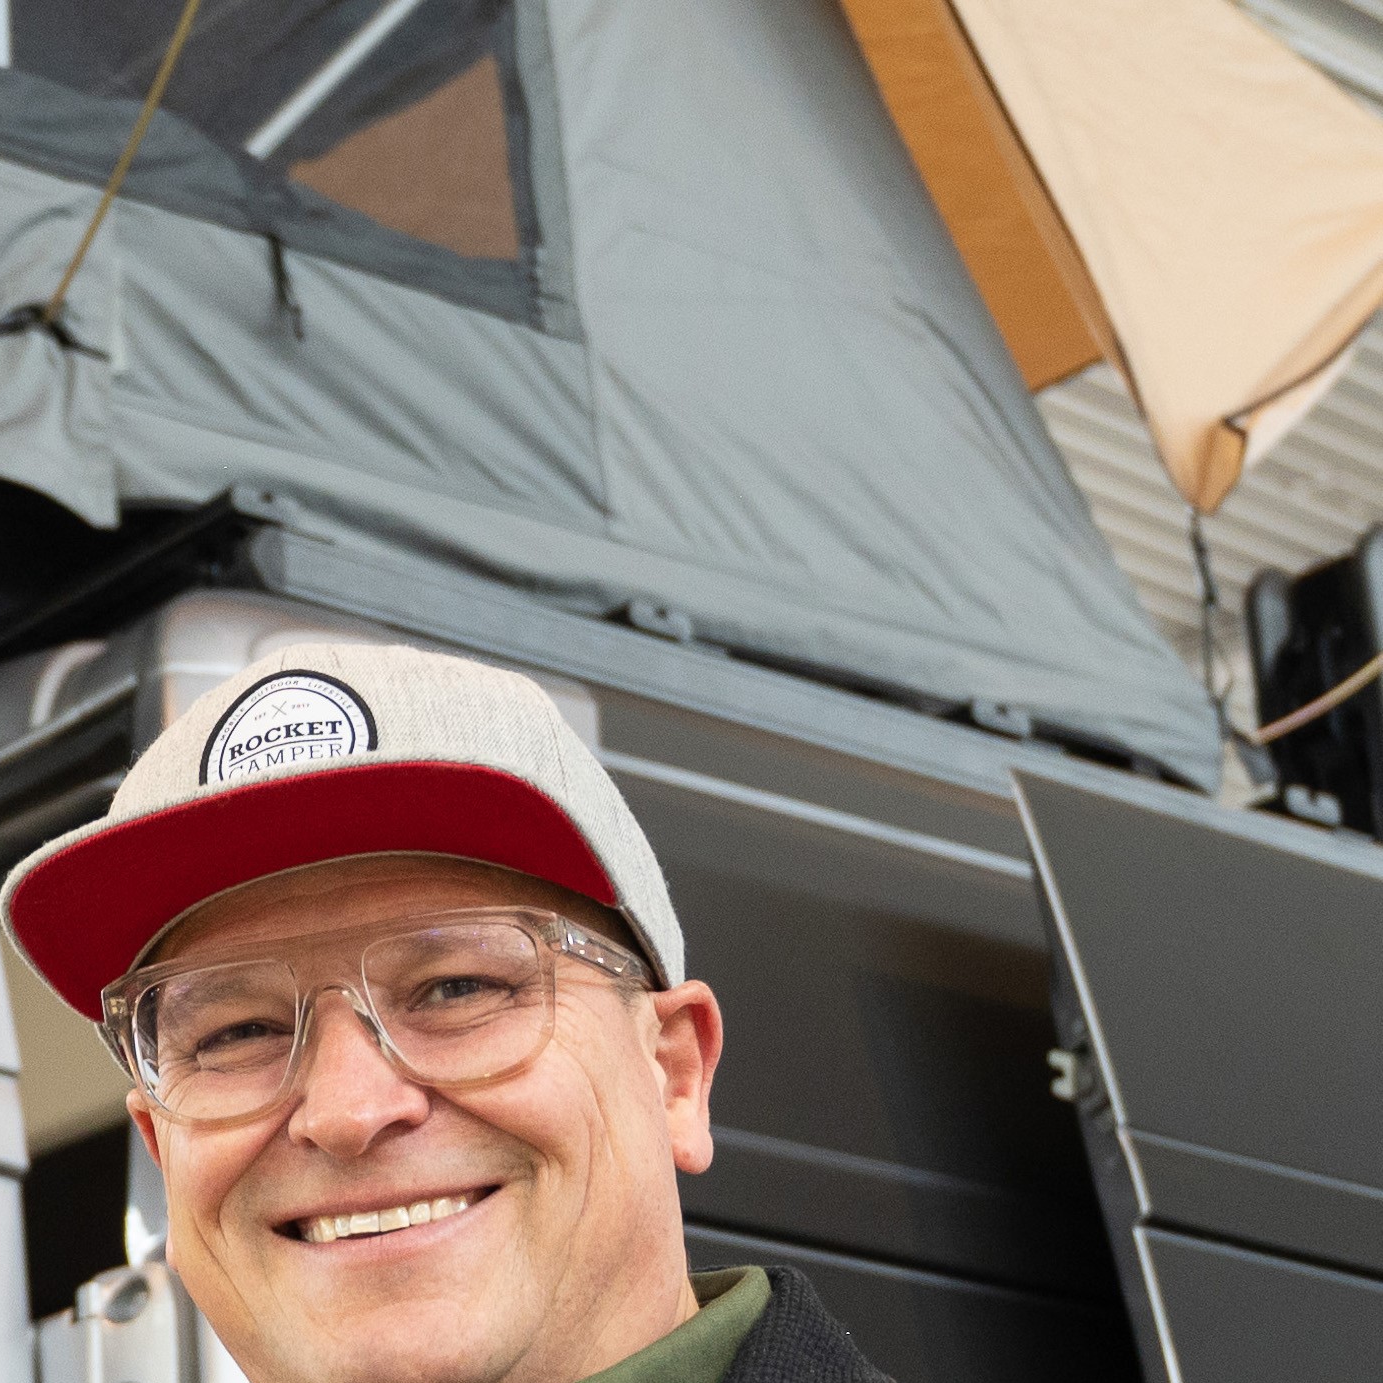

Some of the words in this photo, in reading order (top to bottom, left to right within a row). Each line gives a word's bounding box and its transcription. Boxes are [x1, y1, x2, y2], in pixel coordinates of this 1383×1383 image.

[219, 706, 246, 741] MOBILE
[249, 680, 300, 704] OUTDOOR
[307, 681, 354, 711] LIFESTYLE
[228, 720, 343, 761] ROCKET
[228, 743, 343, 779] CAMPER
